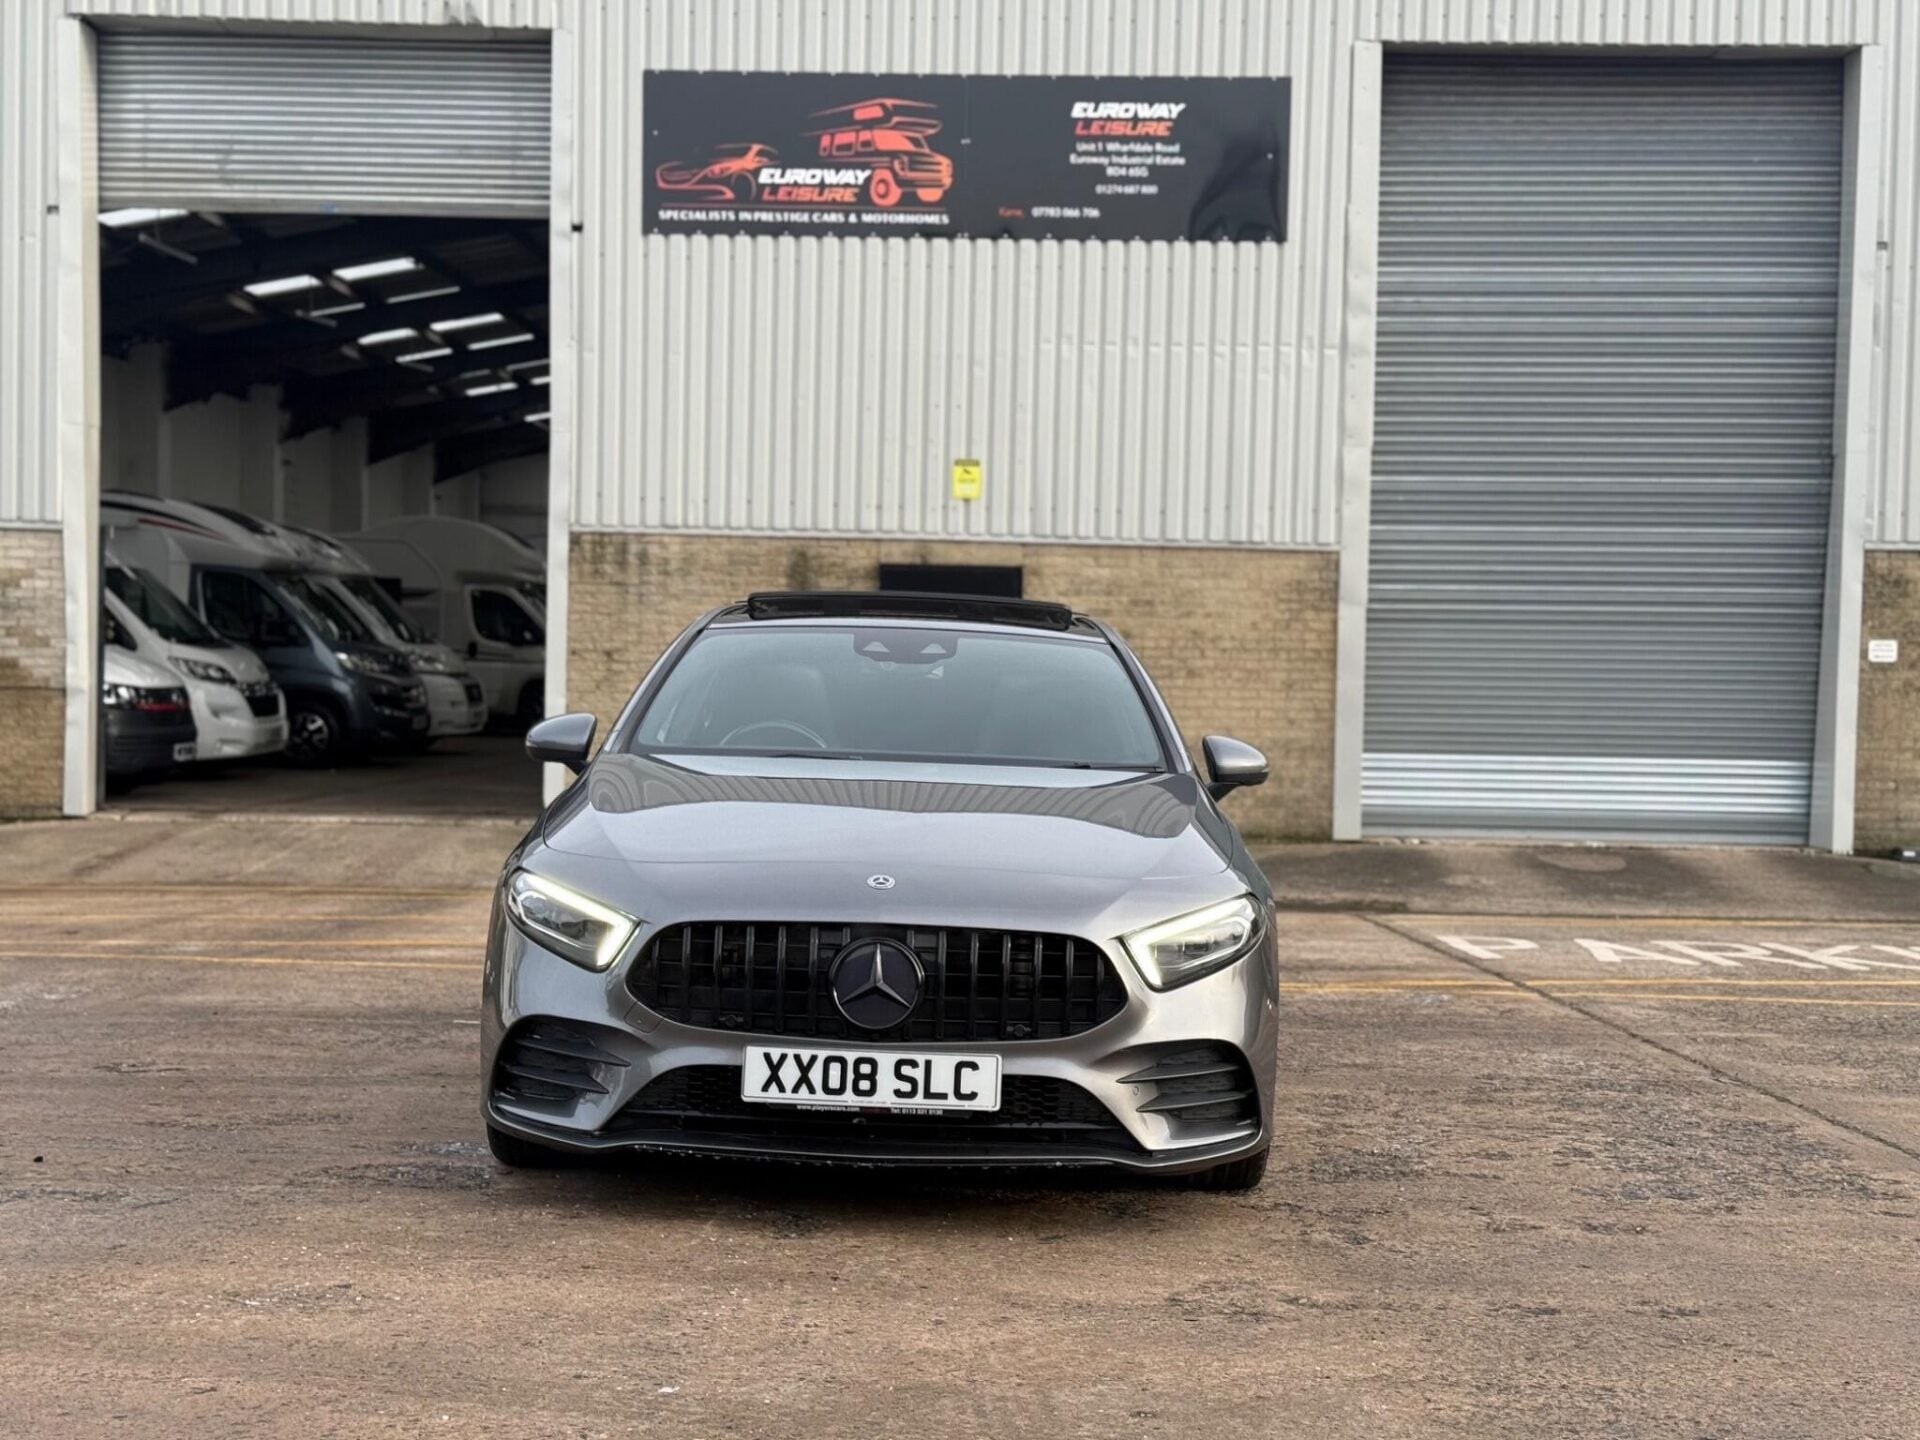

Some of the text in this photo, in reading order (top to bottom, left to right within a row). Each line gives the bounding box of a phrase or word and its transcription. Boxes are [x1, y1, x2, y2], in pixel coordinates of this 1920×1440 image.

[1070, 102, 1186, 119] EUROWAY
[1075, 120, 1174, 136] LEISURE
[1155, 142, 1180, 153] Road
[1069, 153, 1186, 166] Euroway Industrial Estate
[758, 167, 872, 185] EUROWAY
[762, 187, 860, 202] LEISURE
[658, 209, 950, 224] SPECIALISTS IN PRESTIGE CARS & MOTORHOMES
[760, 1051, 980, 1102] XX08 SLC
